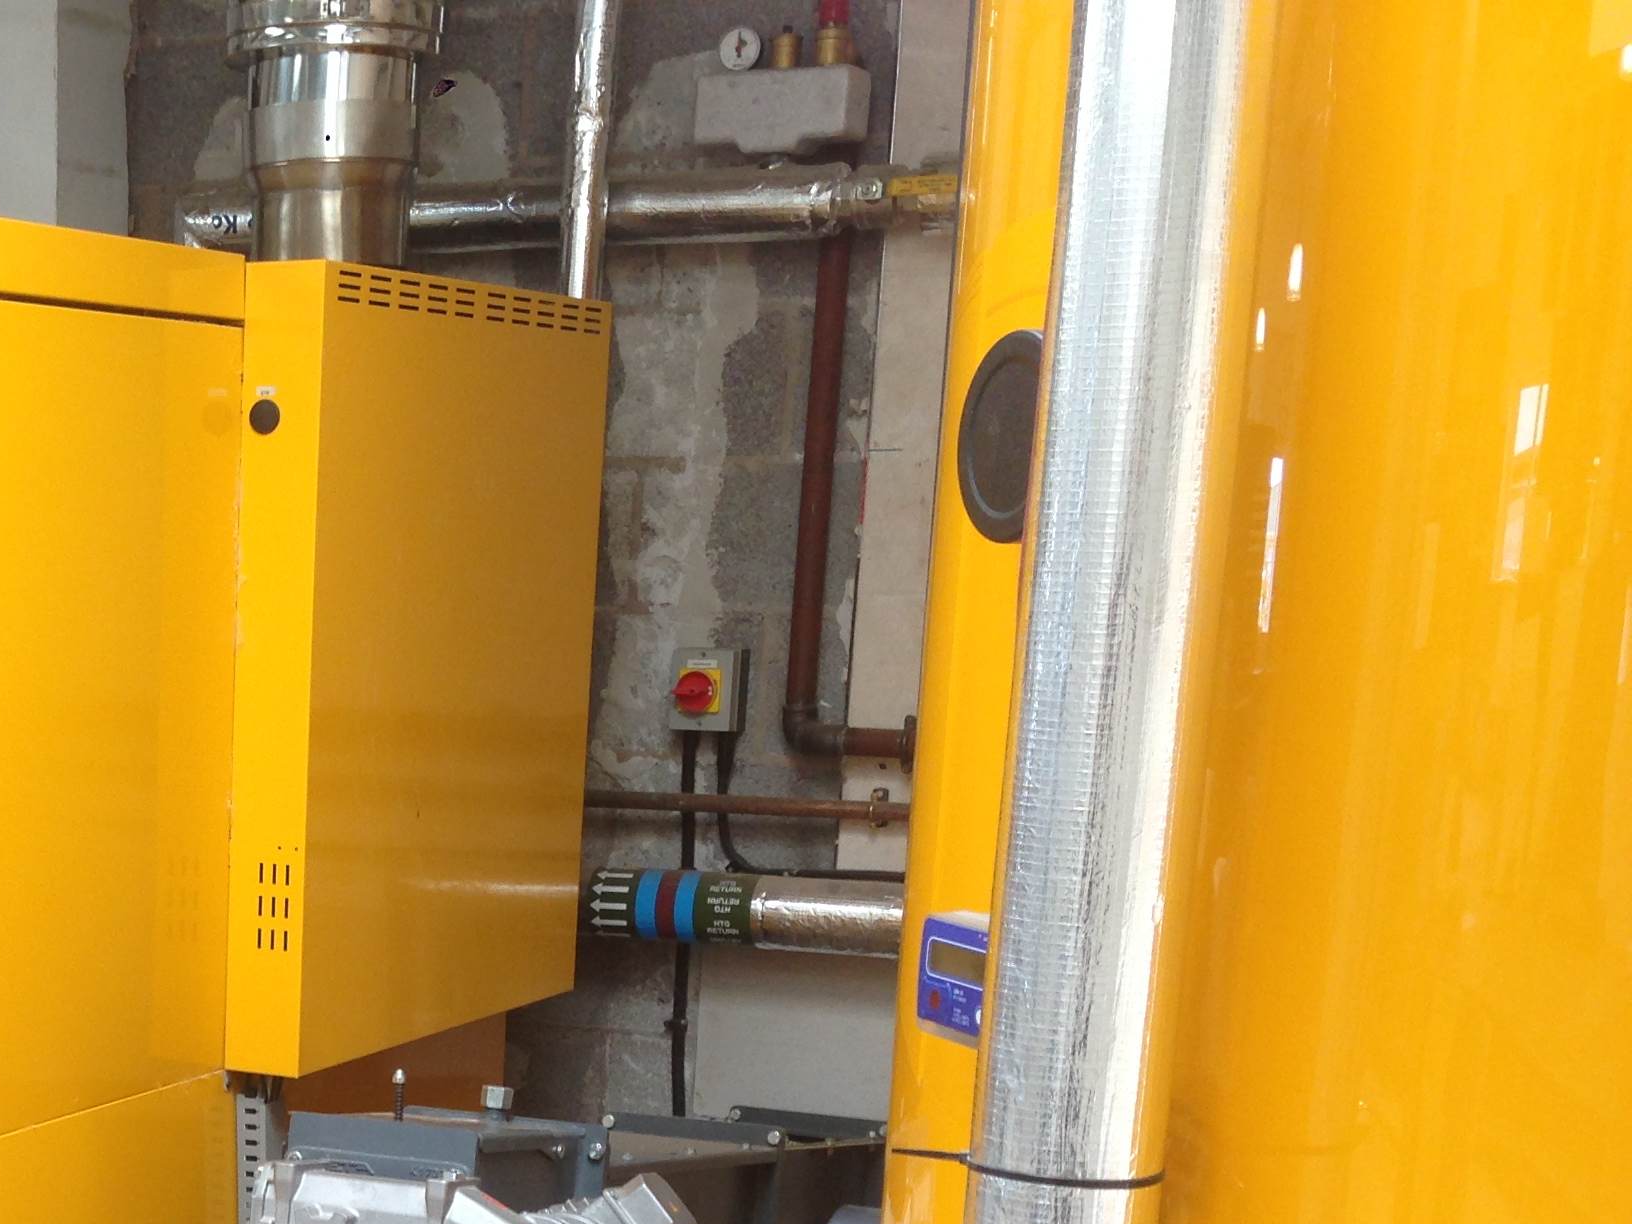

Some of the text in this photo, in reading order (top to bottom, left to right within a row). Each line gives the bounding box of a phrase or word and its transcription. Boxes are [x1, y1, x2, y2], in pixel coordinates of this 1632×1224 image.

[709, 885, 743, 893] RETURN
[707, 896, 741, 905] RETURN
[706, 927, 740, 935] RETURN
